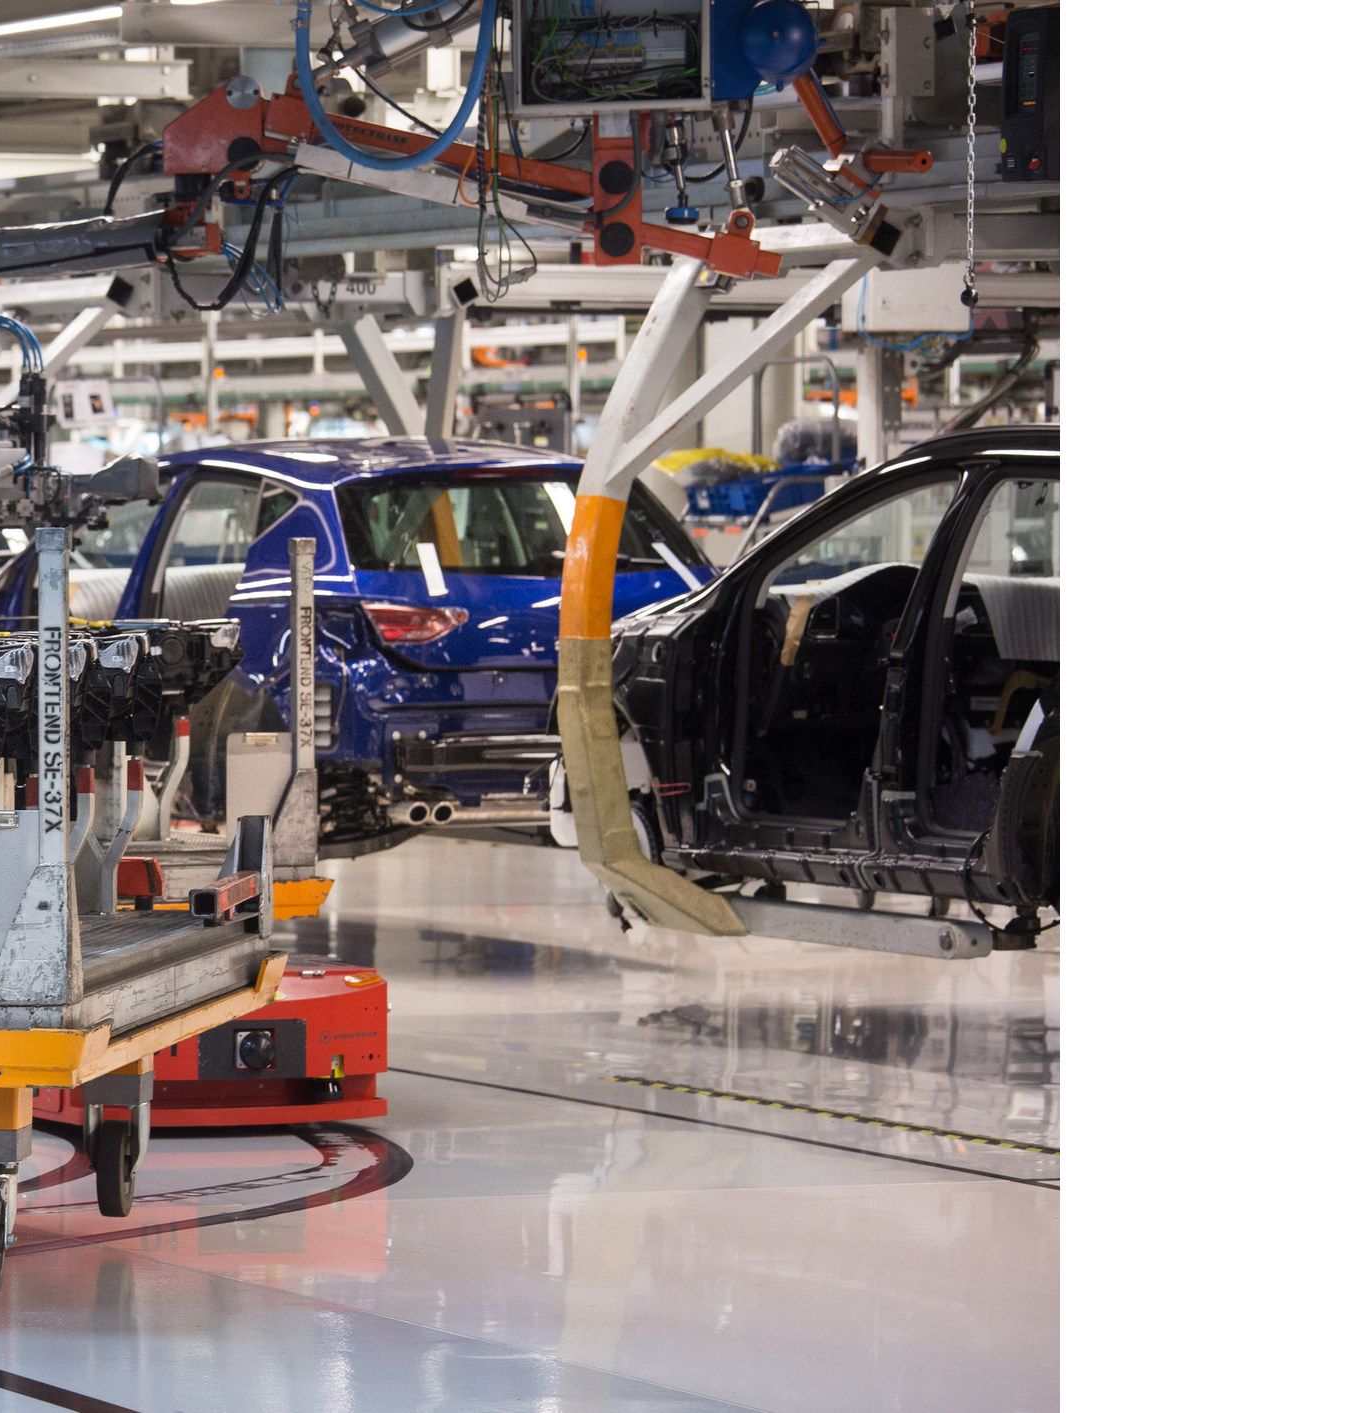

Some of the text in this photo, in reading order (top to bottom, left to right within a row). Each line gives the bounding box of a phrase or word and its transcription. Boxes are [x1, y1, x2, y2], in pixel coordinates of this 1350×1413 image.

[43, 626, 63, 834] FRONTEND SE-37X
[299, 606, 312, 748] FRONTEND SE-37X
